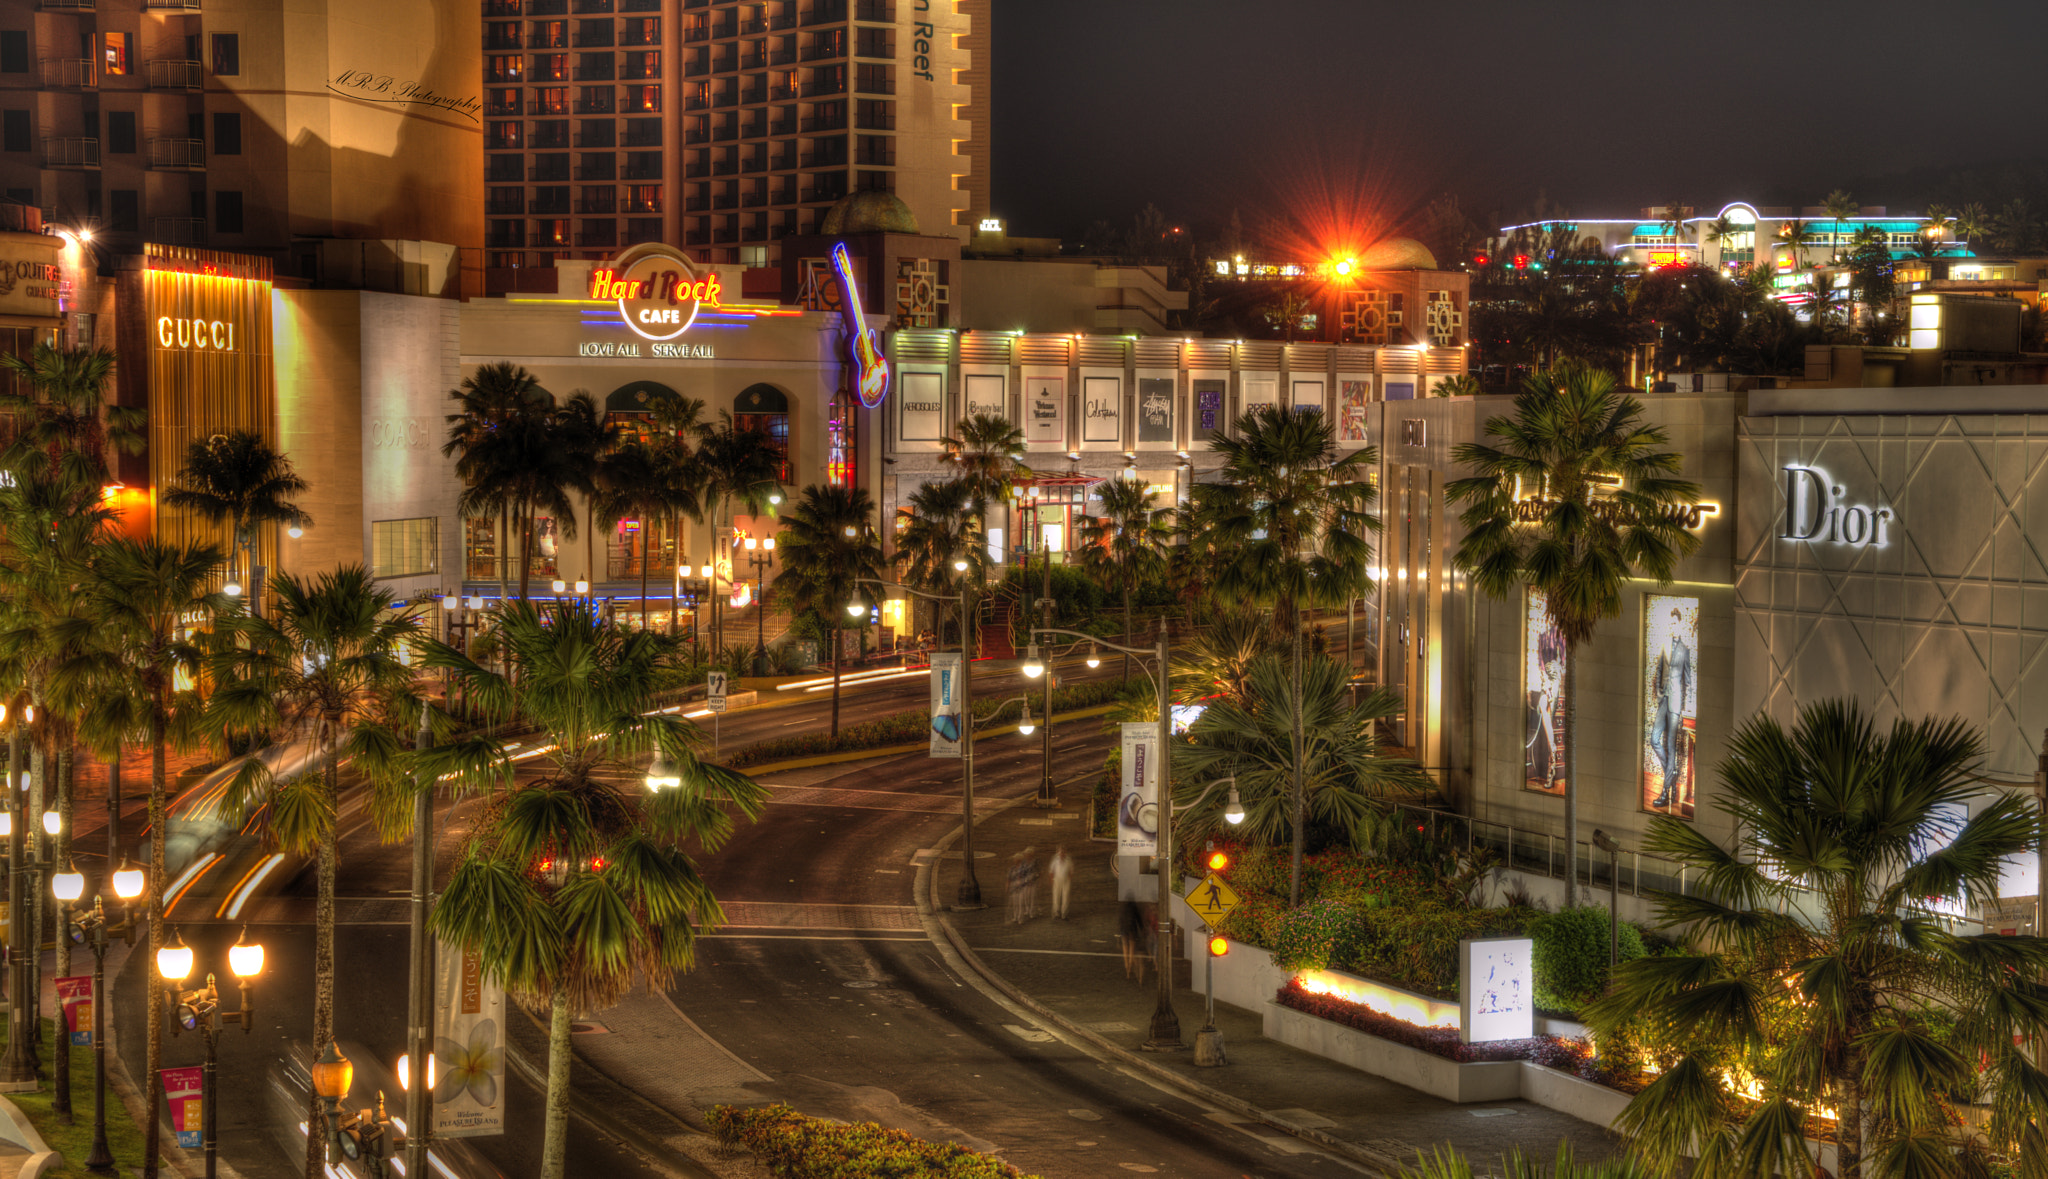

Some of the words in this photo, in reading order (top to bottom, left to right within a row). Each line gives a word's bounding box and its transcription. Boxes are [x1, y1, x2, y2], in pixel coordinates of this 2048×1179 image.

[913, 21, 934, 82] Reef
[591, 269, 656, 300] Hard
[659, 270, 722, 308] Rock
[639, 308, 681, 324] CAFE
[158, 316, 234, 351] GUCCI
[580, 342, 615, 356] LOVE
[617, 343, 642, 356] ALL
[652, 343, 691, 357] SERVE
[691, 344, 716, 358] ALL
[904, 402, 941, 411] AEROSOLES
[992, 402, 1003, 413] bar
[372, 420, 431, 448] COACH
[1777, 463, 1893, 548] Dior
[474, 1117, 499, 1126] ISLAND
